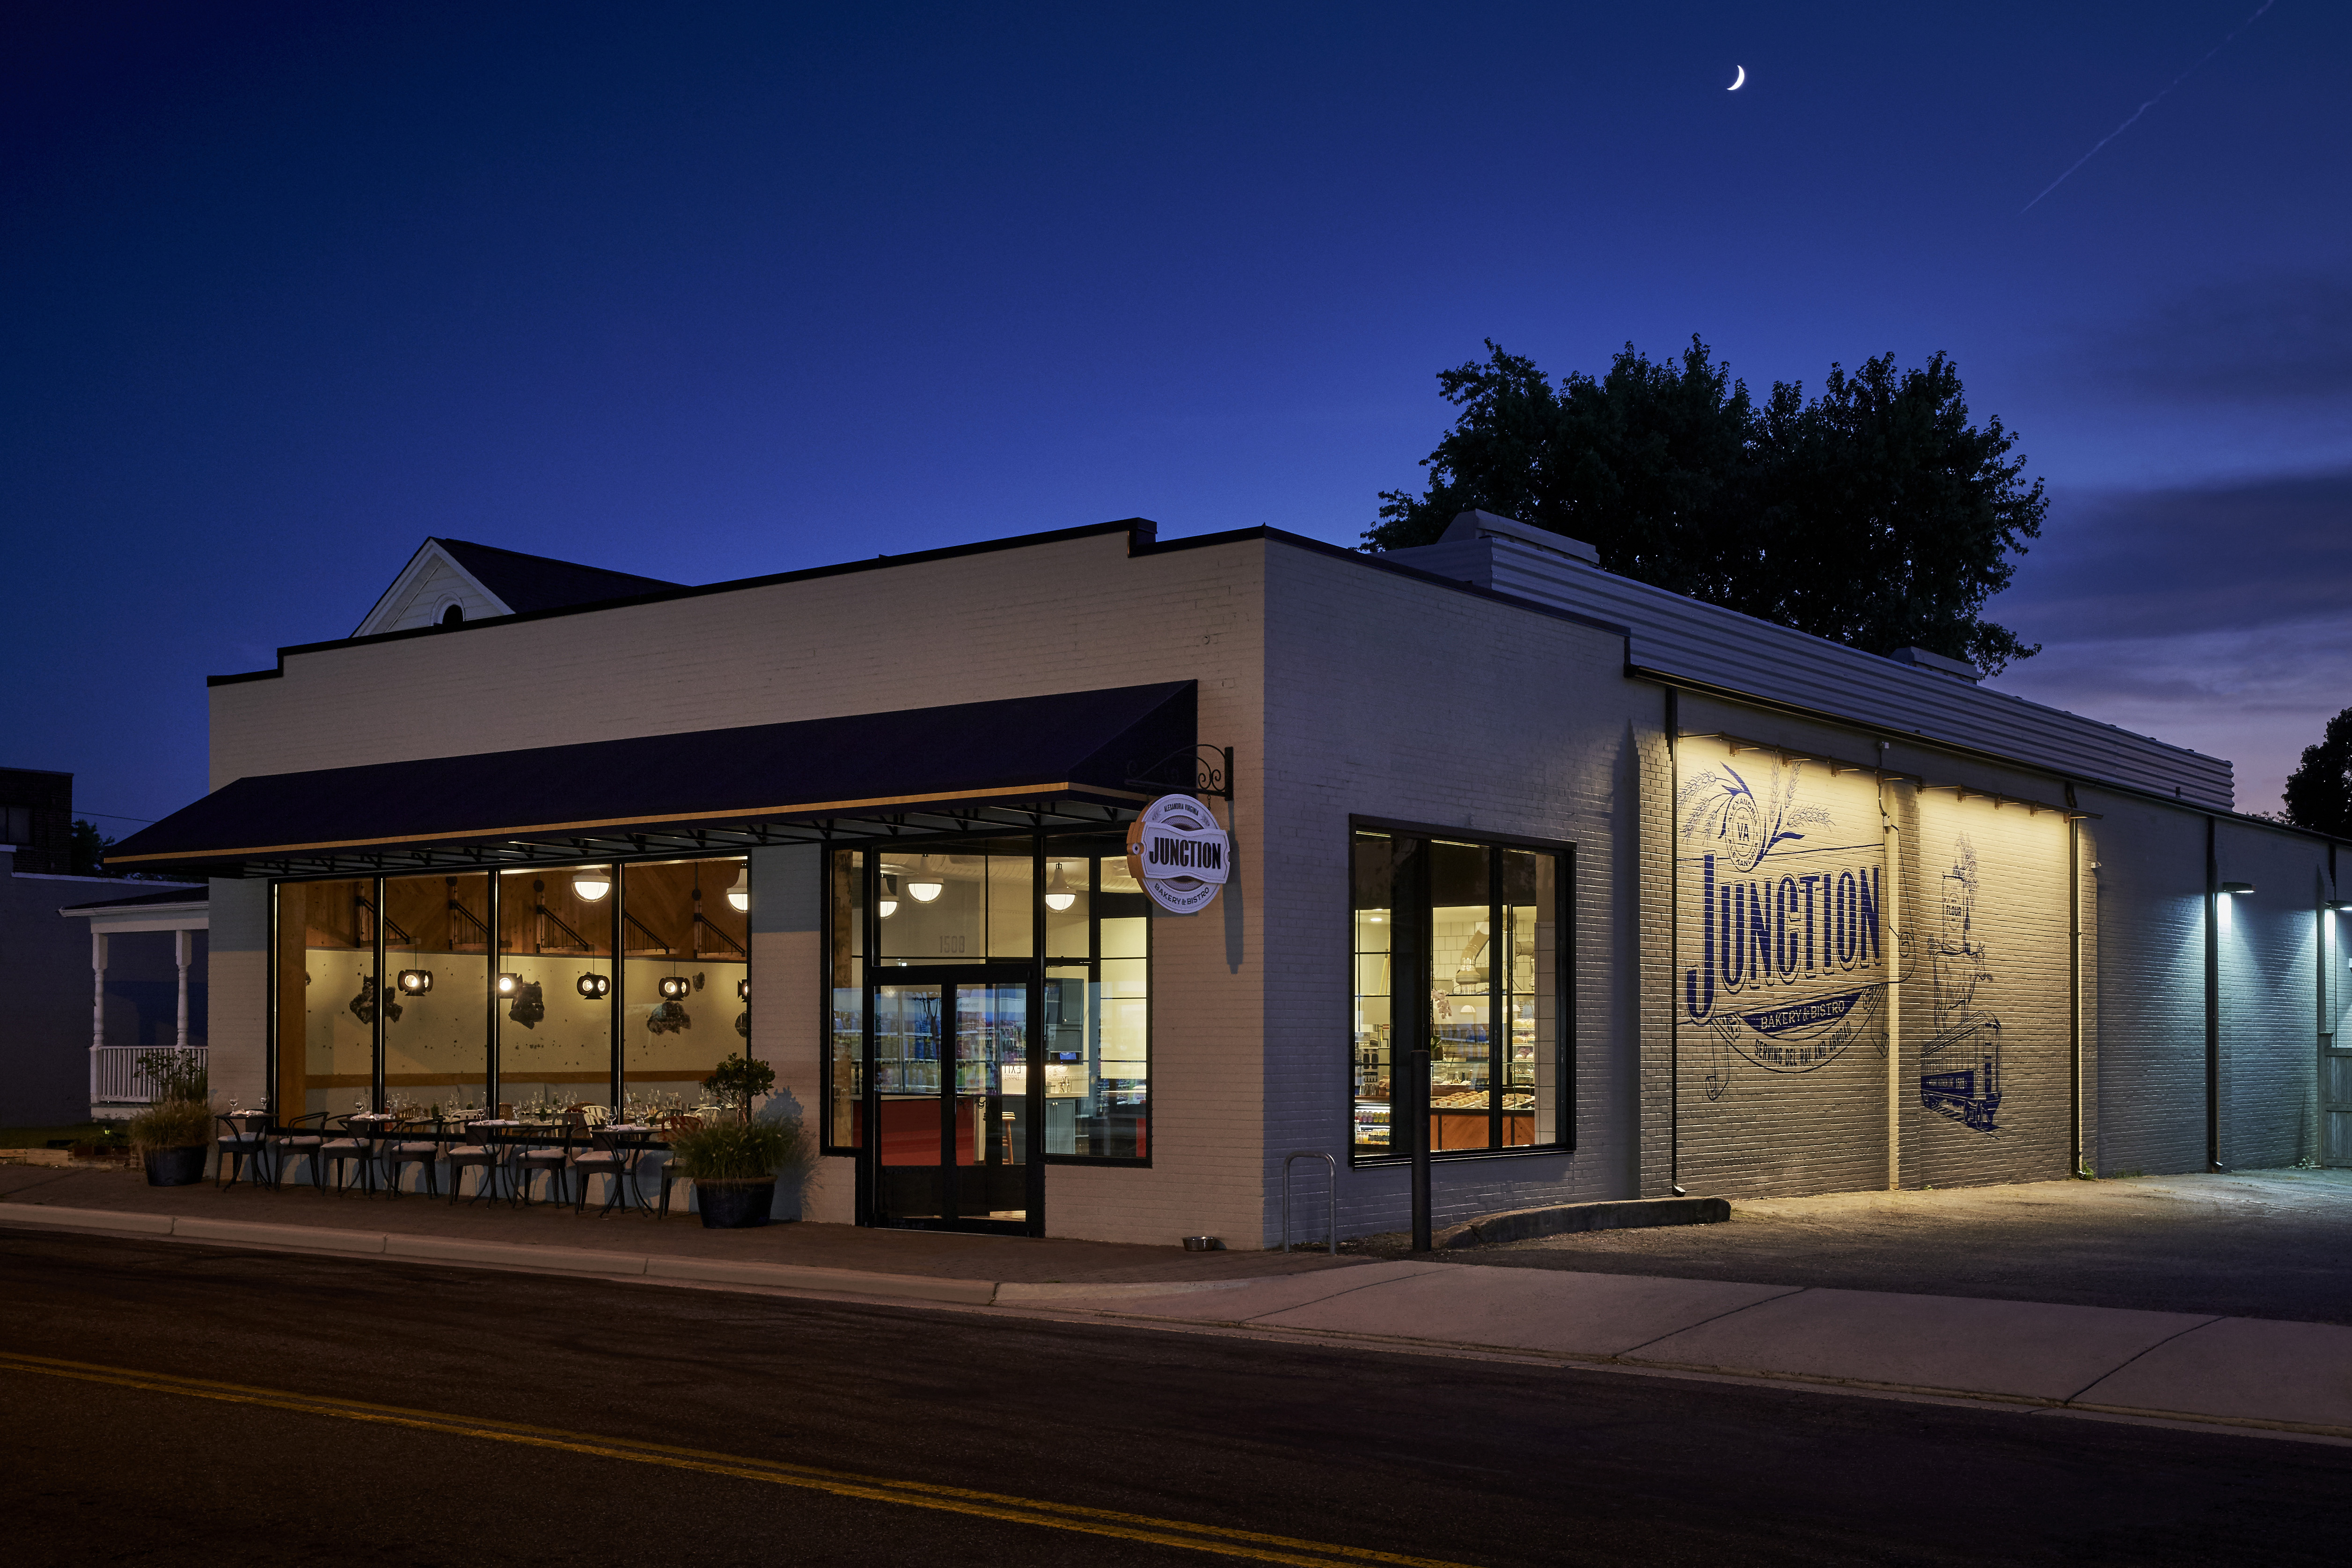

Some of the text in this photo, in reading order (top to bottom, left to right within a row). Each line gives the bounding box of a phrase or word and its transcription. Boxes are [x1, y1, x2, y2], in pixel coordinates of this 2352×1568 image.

[1164, 803, 1199, 816] ALEXANDRIA VIRGINIA
[1728, 798, 1758, 827] ALEXANDRIA
[1737, 822, 1750, 842] VA
[1149, 837, 1221, 869] JUNCTION
[1154, 883, 1181, 904] BAKERY
[1187, 887, 1209, 904] BISTRO
[1946, 905, 1961, 916] FLOUR
[1686, 853, 1881, 1020] JUNCTION
[1761, 1010, 1802, 1029] BAKERY
[1811, 1001, 1845, 1018] BISTRO
[1755, 1021, 1851, 1065] SERVING DEL RAY AND ABROAD
